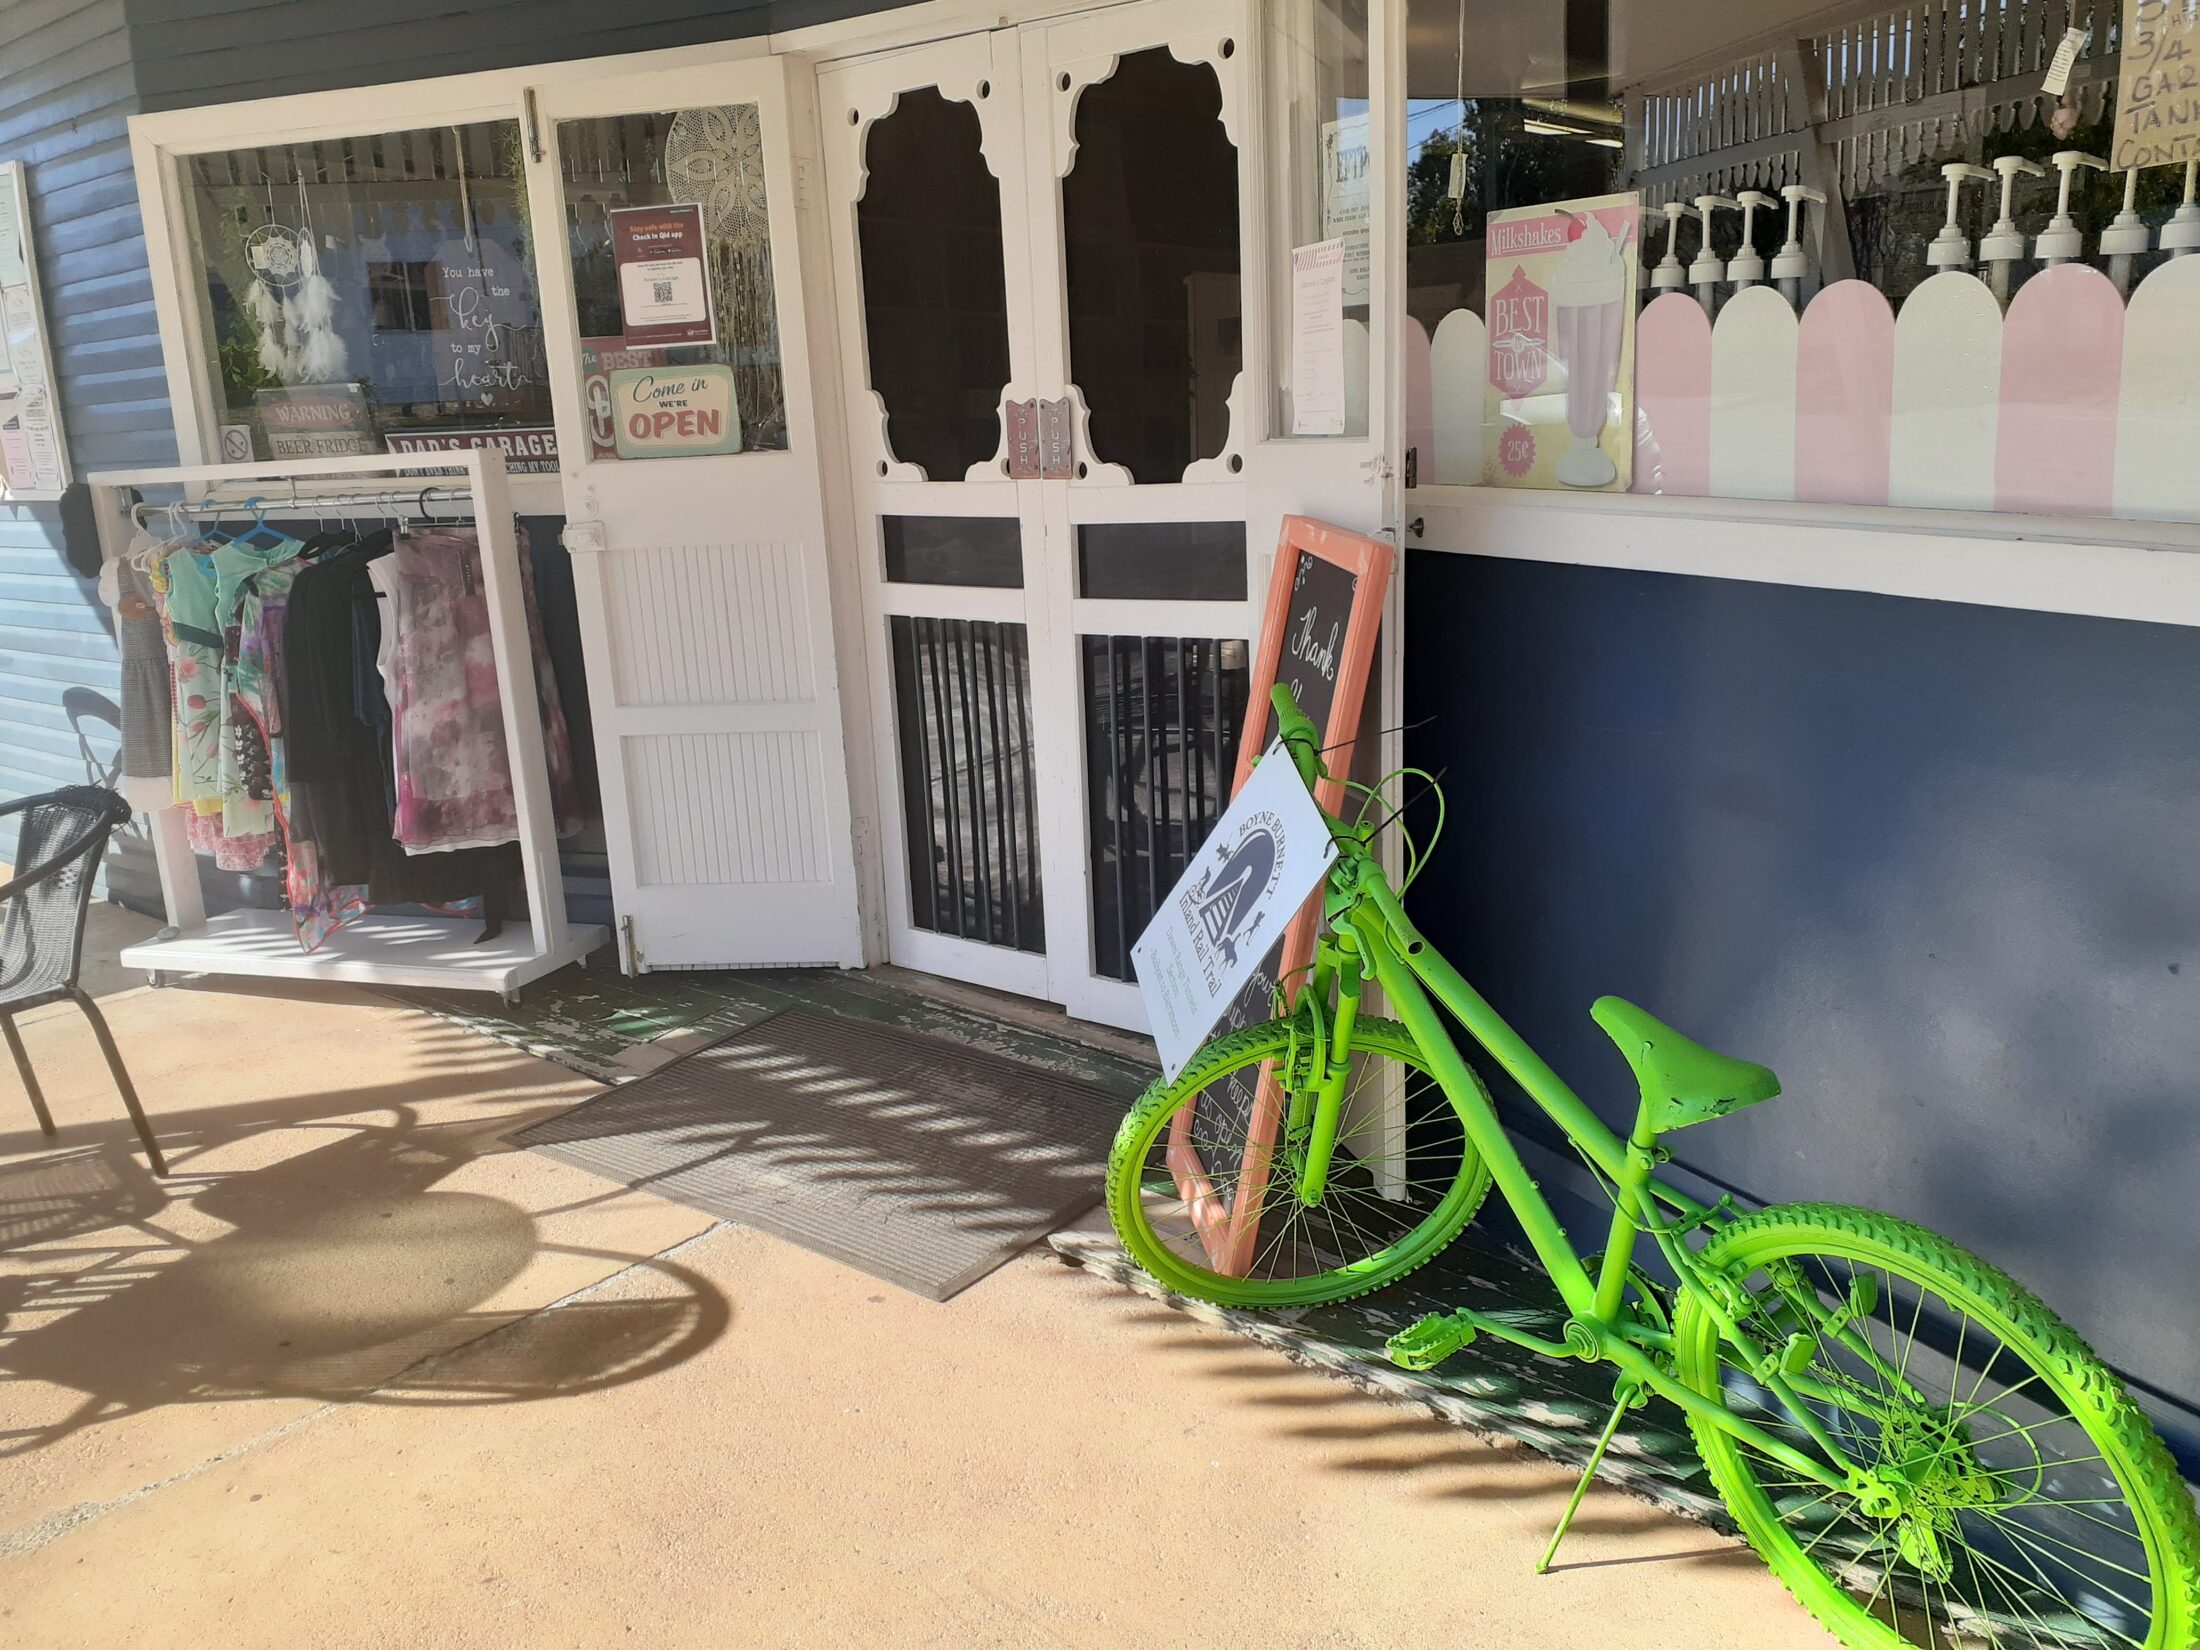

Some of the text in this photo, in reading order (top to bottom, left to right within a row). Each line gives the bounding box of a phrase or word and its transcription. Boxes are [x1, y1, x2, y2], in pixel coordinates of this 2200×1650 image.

[632, 233, 651, 241] Check
[660, 231, 670, 239] Qld
[671, 231, 683, 239] app
[1490, 225, 1562, 256] Milkshakes
[441, 267, 494, 278] You have
[491, 286, 511, 296] the
[433, 287, 520, 352] key
[1494, 296, 1545, 337] BEST
[450, 343, 482, 355] to my
[599, 350, 653, 369] BEST
[440, 357, 532, 391] heart
[1494, 348, 1542, 382] TOWN
[632, 375, 708, 403] Come in
[659, 399, 688, 408] WE'RE
[275, 403, 351, 422] WARNING
[628, 409, 720, 440] OPEN
[276, 438, 311, 455] BEER
[1018, 417, 1028, 465] PUSH
[1051, 416, 1061, 465] PUSH
[1291, 606, 1339, 681] Thank
[1238, 810, 1287, 900] BOYNE BURNETT
[1179, 889, 1223, 999] Inland Rail Trail
